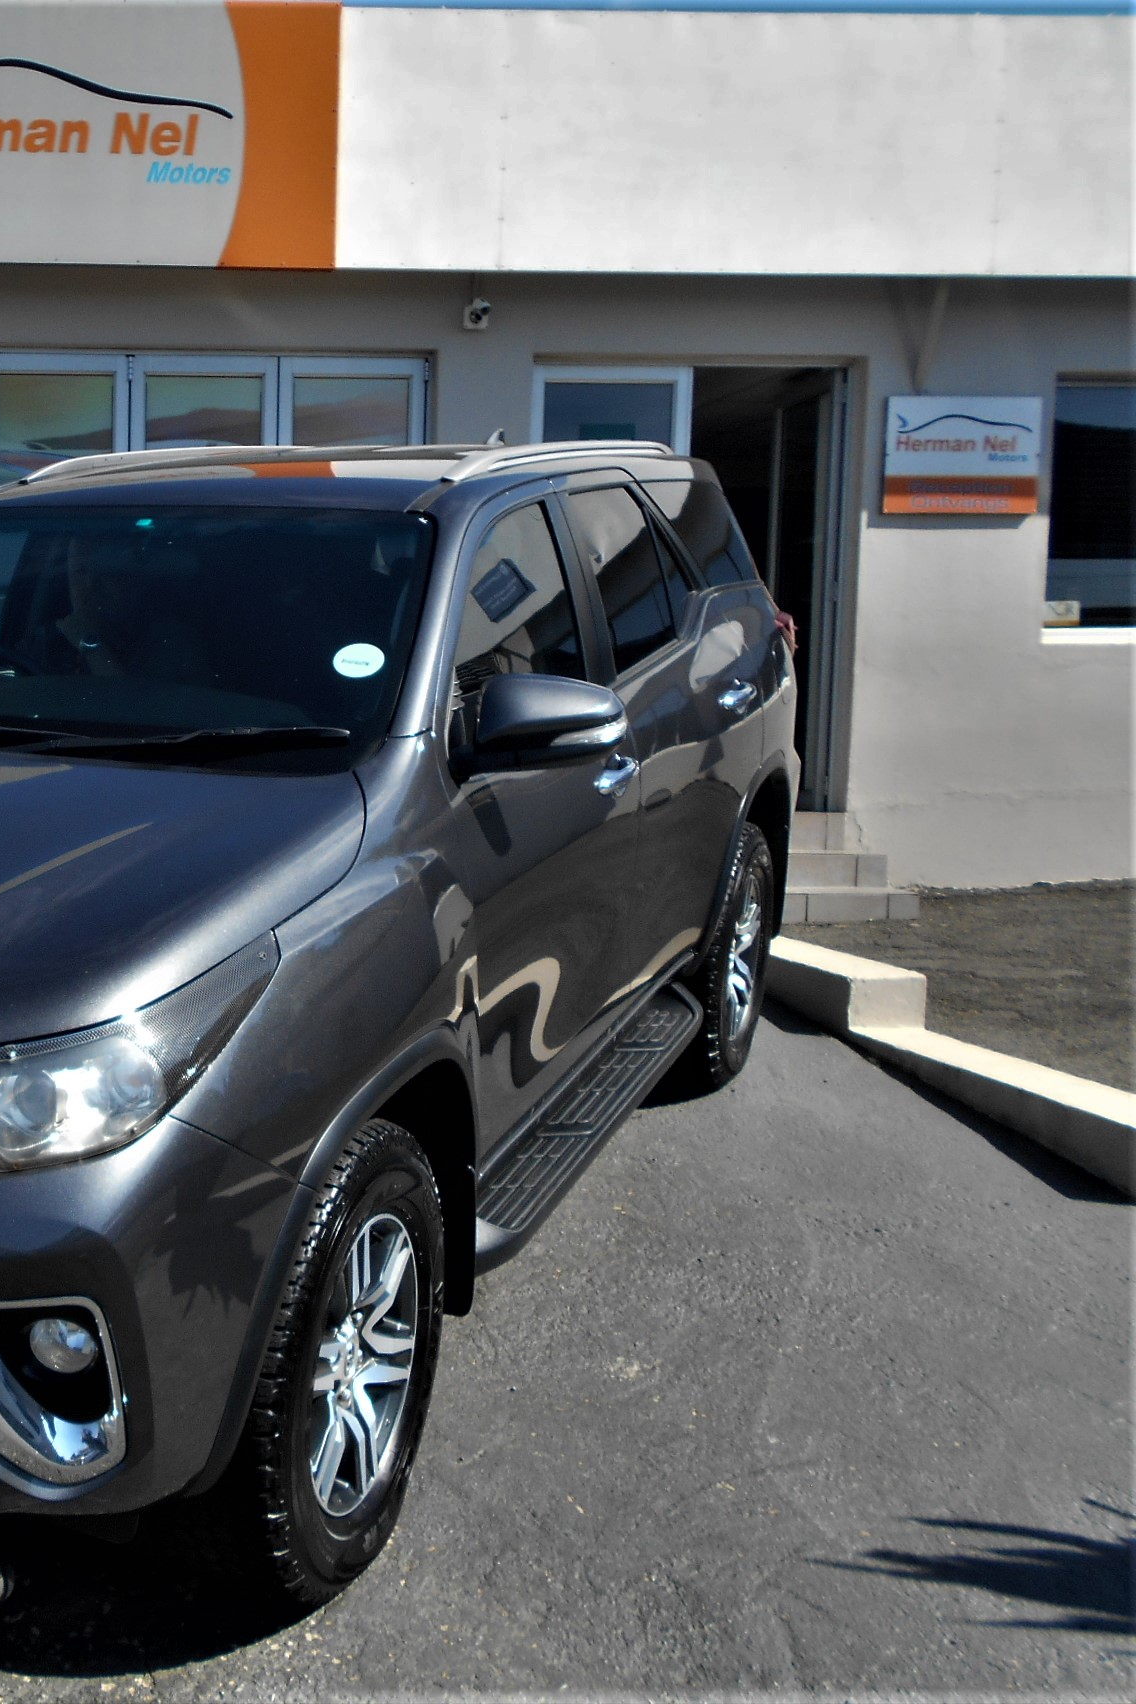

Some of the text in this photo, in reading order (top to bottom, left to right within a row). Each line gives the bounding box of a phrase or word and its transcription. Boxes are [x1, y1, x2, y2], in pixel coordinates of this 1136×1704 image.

[109, 111, 200, 157] Nel
[146, 161, 232, 185] Motors
[895, 434, 1018, 452] Herman Nel
[987, 452, 1029, 462] Motors
